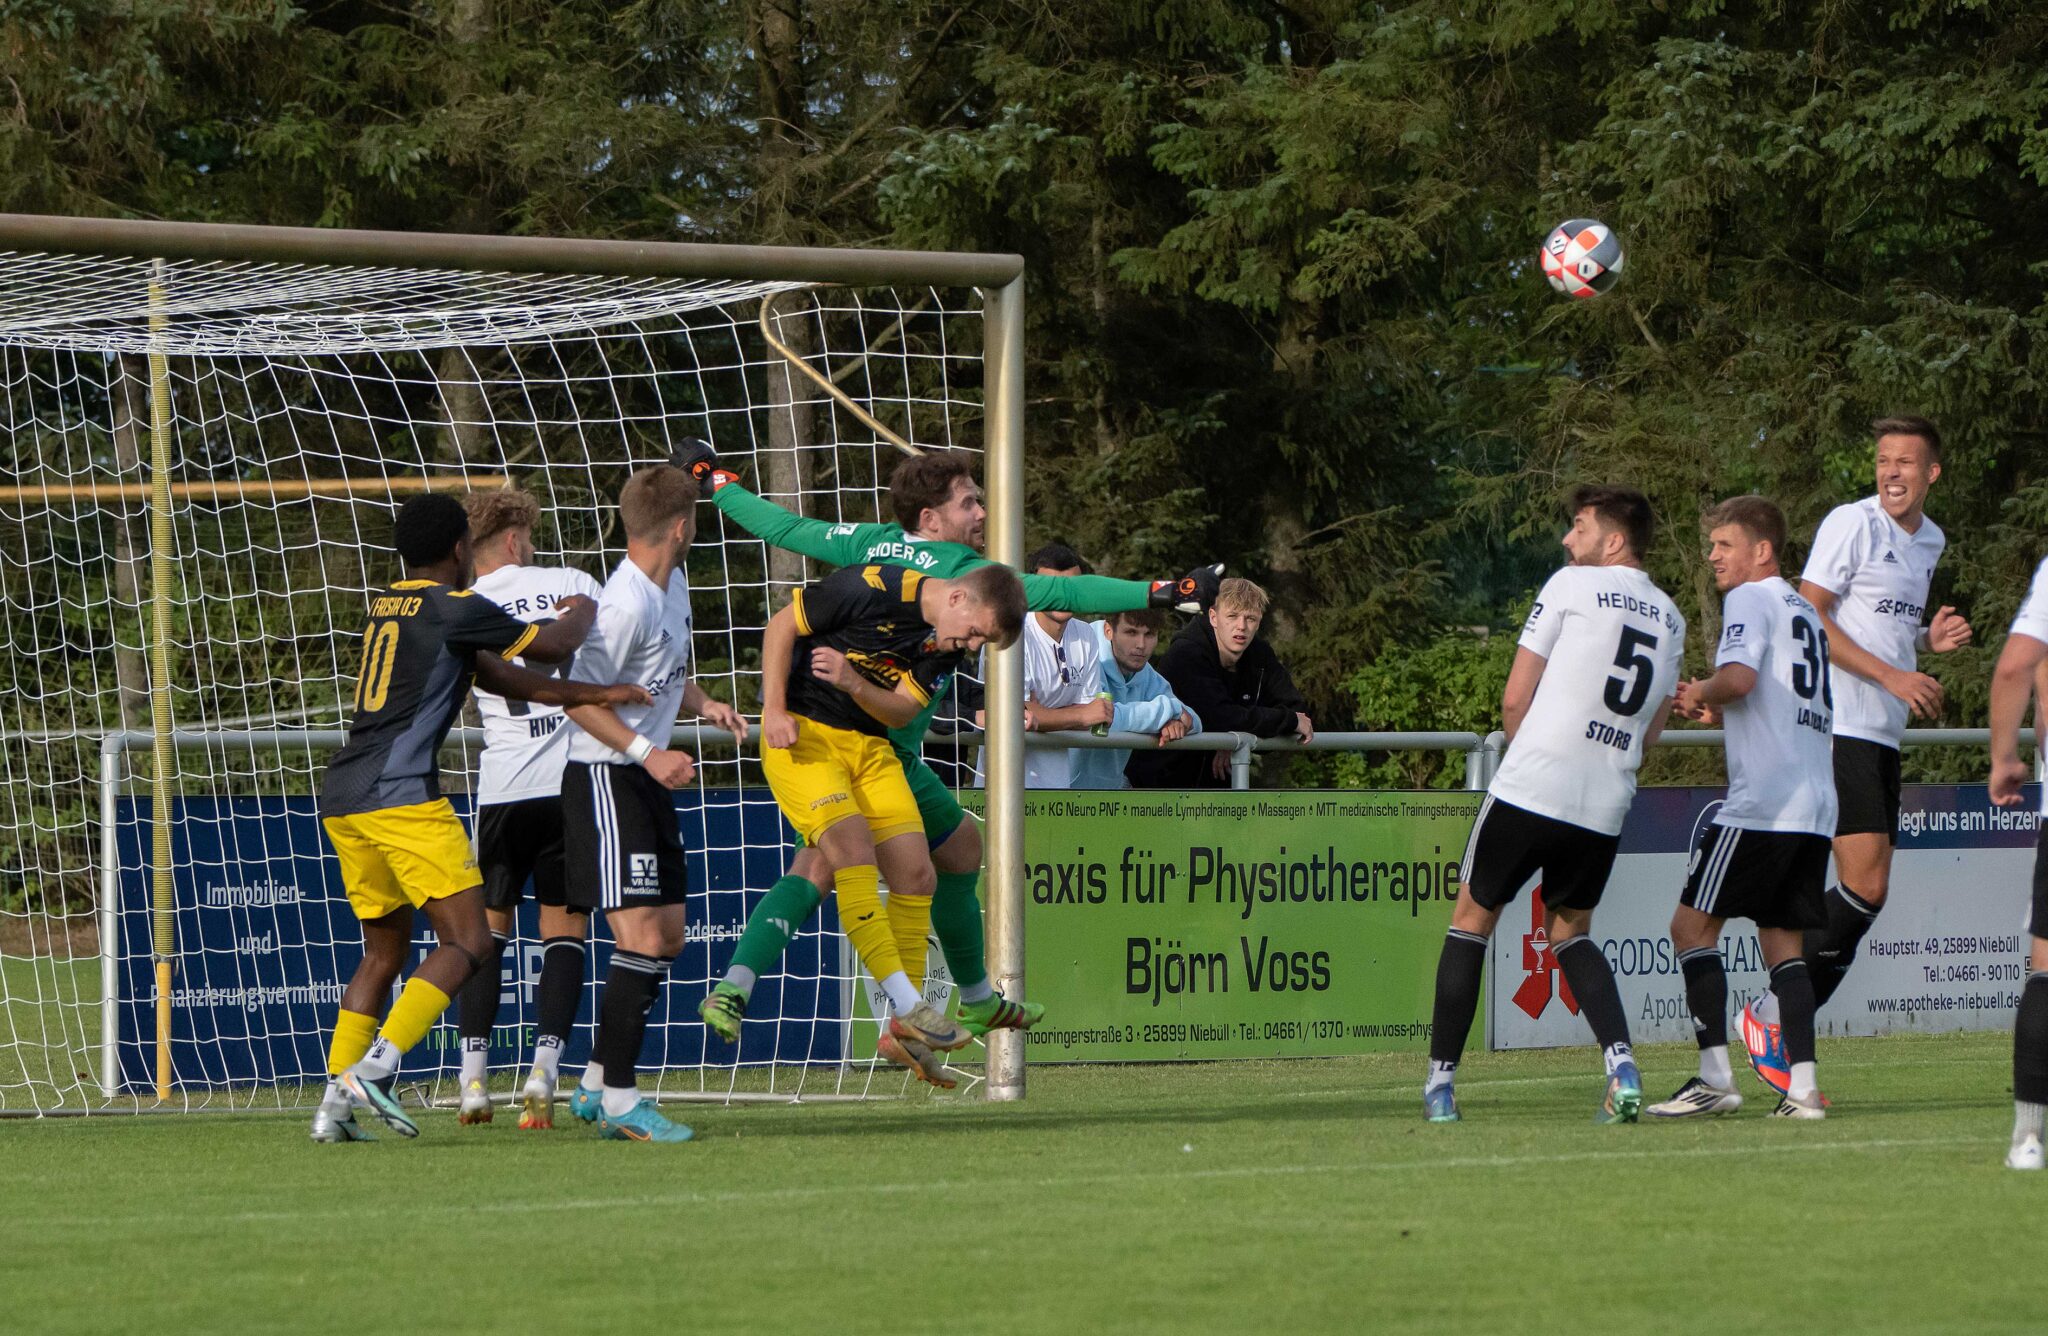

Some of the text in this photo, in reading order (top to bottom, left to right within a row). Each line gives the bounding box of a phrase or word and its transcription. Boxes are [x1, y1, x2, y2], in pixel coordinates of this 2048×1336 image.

[915, 550, 939, 569] SV
[401, 596, 423, 617] 03
[1597, 592, 1660, 622] HEIDER
[354, 620, 400, 713] 10
[1603, 624, 1658, 717] 5
[529, 715, 565, 738] HIN
[1585, 720, 1632, 751] STORB
[1048, 802, 1063, 816] KG
[1065, 802, 1096, 817] Neuro
[1099, 802, 1120, 816] PNF
[1130, 802, 1173, 817] manuelle
[1175, 802, 1248, 821] Lymphdrainage
[1258, 802, 1306, 820] Massagen
[1316, 802, 1337, 816] MTT
[1339, 802, 1399, 817] medizinische
[1400, 802, 1479, 820] Trainingstherapie
[1929, 810, 1958, 832] uns
[1960, 810, 1985, 831] am
[1989, 806, 2042, 831] Herzen
[206, 879, 306, 905] Immobilien-
[1025, 845, 1462, 920] axis für Physiotherapie
[240, 929, 271, 955] und
[1869, 939, 1923, 959] Hauptstr.
[1979, 935, 2020, 953] Niebüll
[1126, 936, 1331, 1007] Björn Voss
[1923, 965, 1946, 983] Tel.:
[1947, 964, 1980, 982] 04661
[1868, 991, 2021, 1015] www.apotheke-niebuell.de
[1025, 1019, 1434, 1049] mooringerstraße 3 25899 Niebüll Tel.: 04661/1370 www.voss-phys
